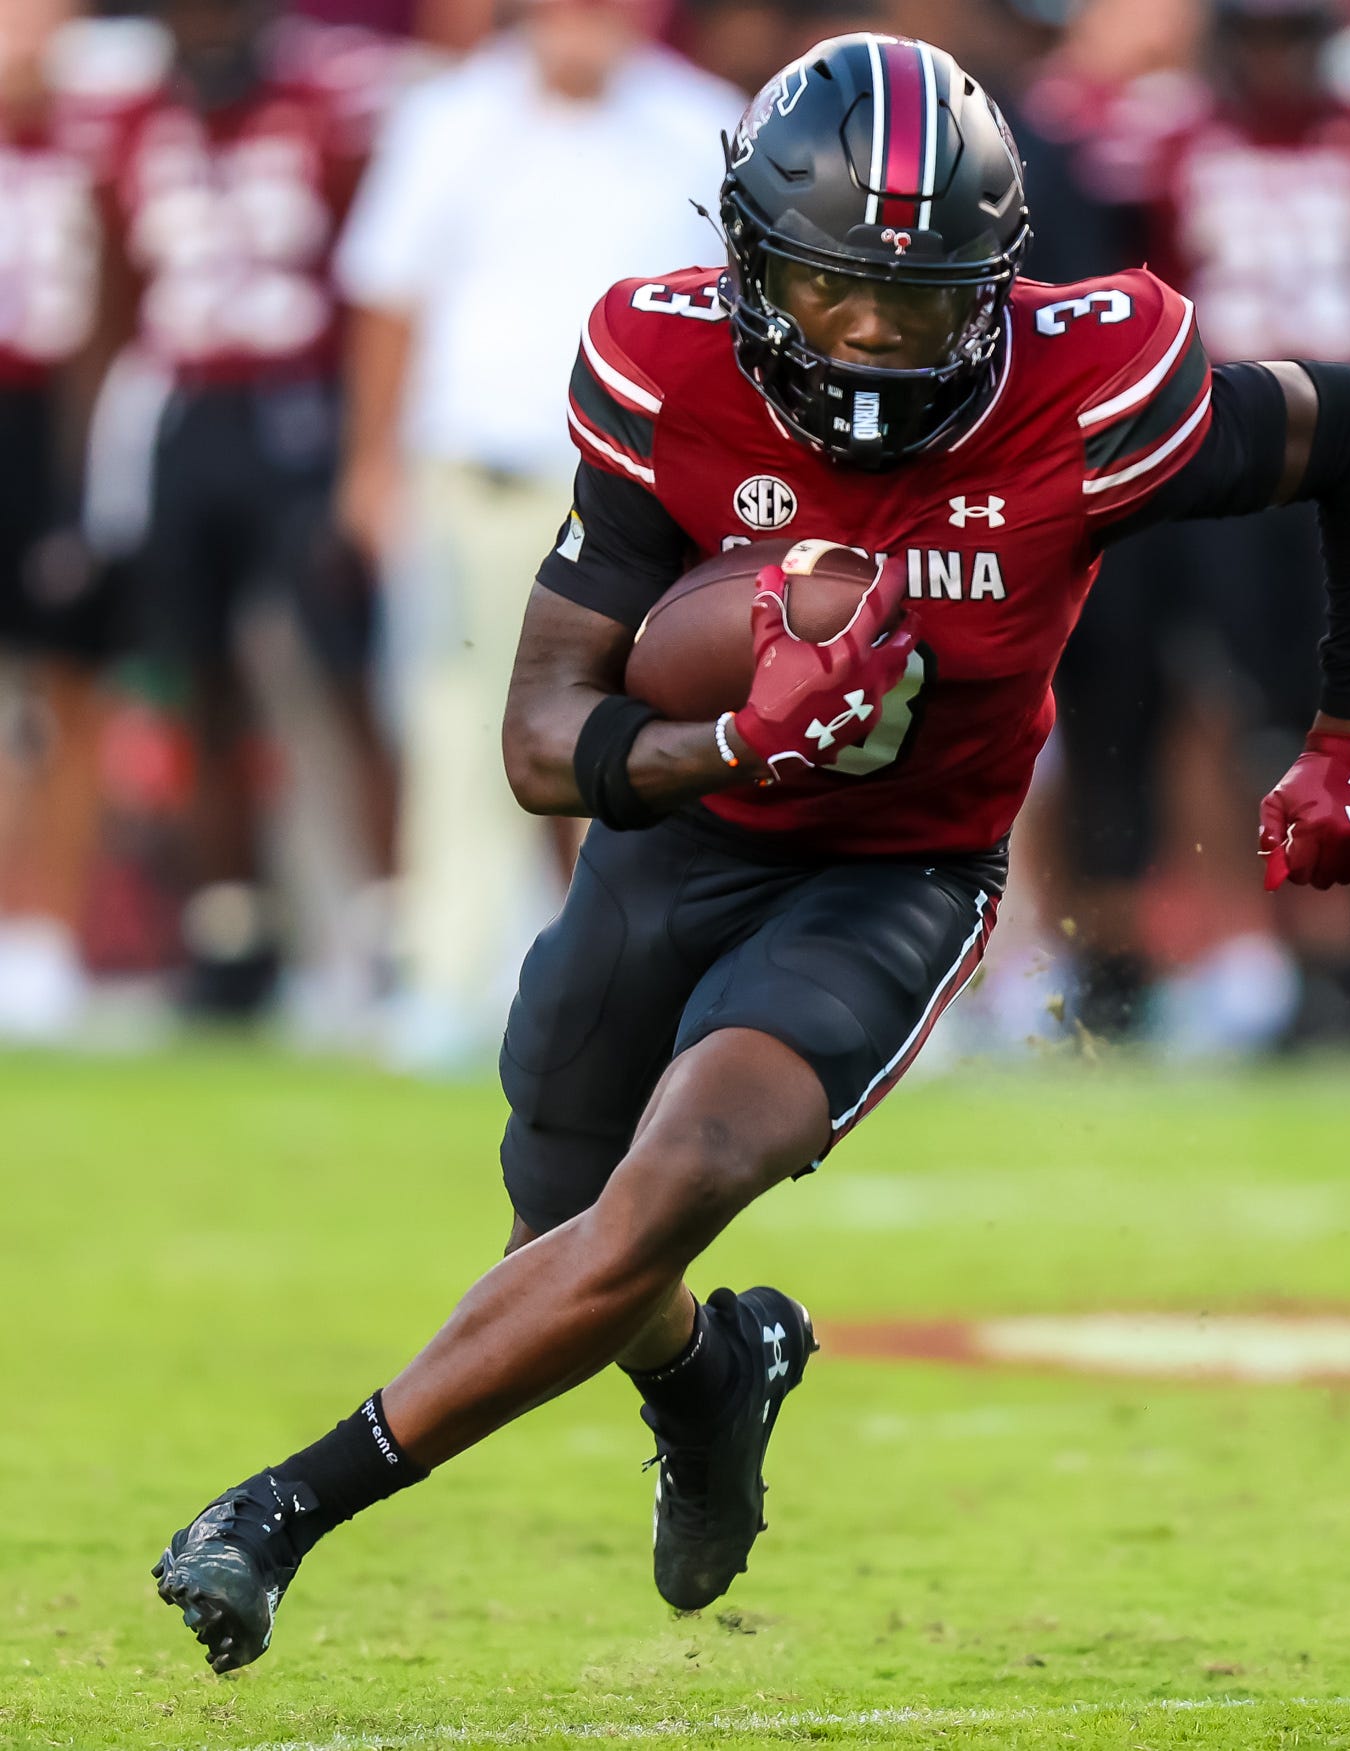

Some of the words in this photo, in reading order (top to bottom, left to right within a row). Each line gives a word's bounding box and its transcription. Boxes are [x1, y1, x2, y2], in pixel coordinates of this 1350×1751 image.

[631, 283, 731, 322] 3
[1036, 289, 1132, 336] 3
[738, 477, 794, 528] SEC
